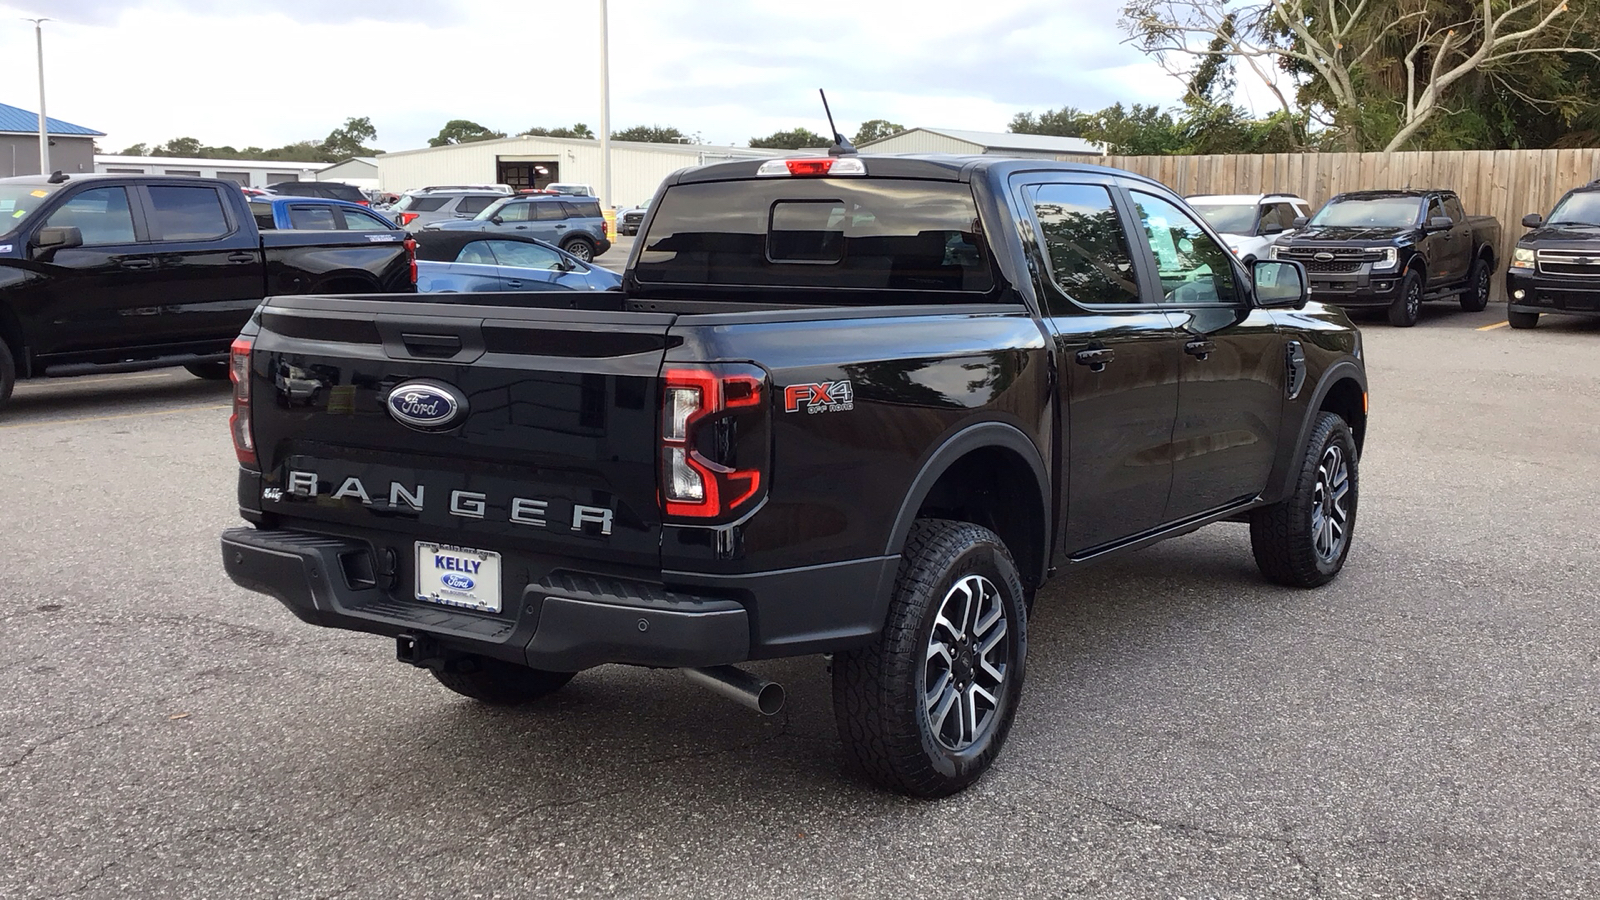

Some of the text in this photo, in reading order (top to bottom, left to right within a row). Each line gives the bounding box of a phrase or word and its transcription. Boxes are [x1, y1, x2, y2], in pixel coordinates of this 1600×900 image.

[402, 392, 439, 416] Ford
[784, 380, 853, 413] FX4
[807, 403, 854, 415] OFF ROAD
[287, 471, 614, 535] RANGER
[434, 555, 482, 575] KELLY
[447, 574, 469, 589] Ford
